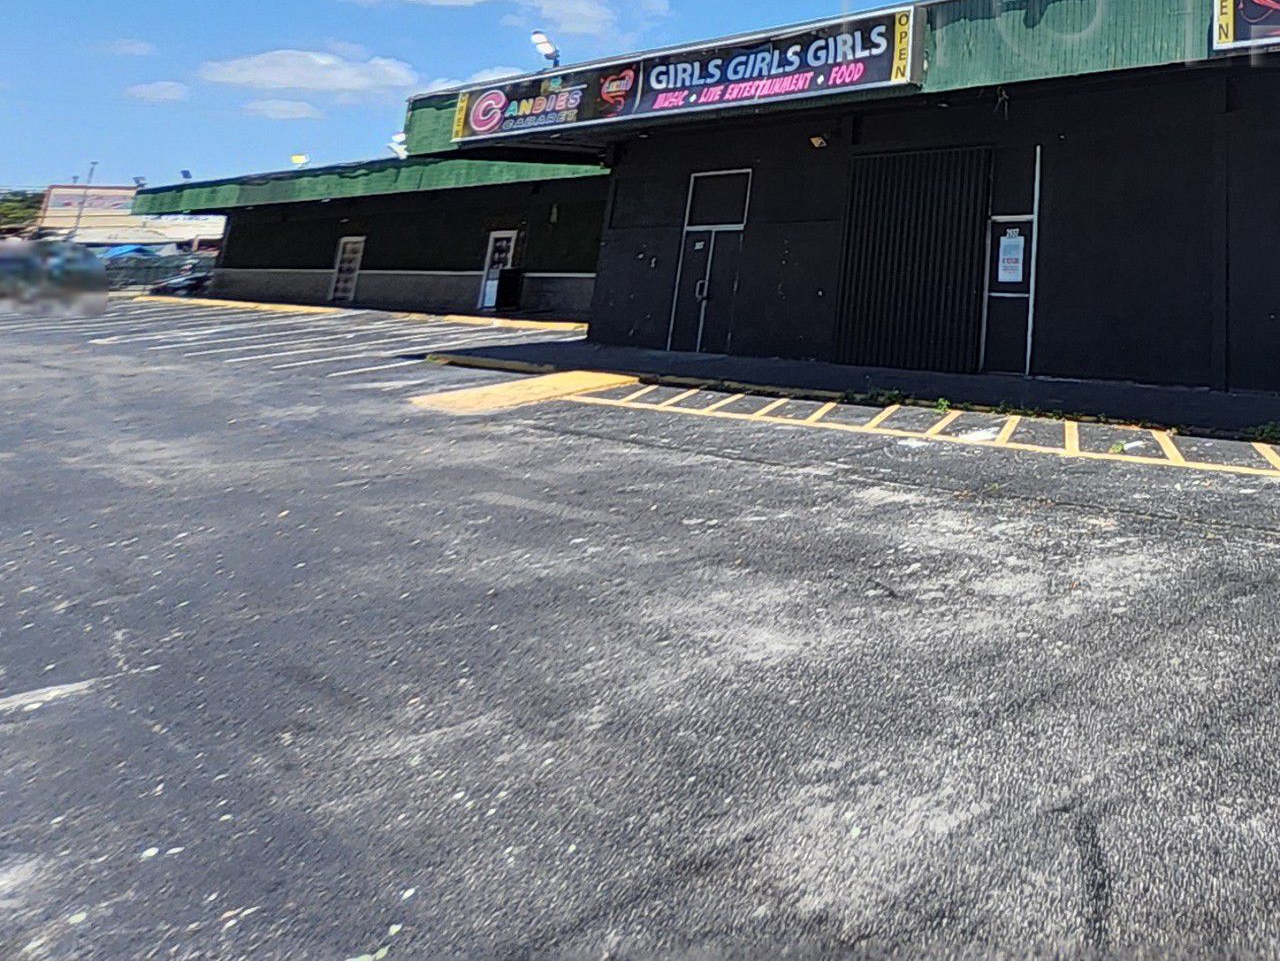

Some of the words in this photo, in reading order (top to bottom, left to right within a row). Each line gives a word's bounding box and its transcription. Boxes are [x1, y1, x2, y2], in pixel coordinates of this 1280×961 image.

[650, 59, 721, 89] GIRLS
[727, 45, 800, 80] GIRLS
[807, 26, 888, 66] GIRLS
[895, 13, 909, 80] OPEN
[470, 89, 583, 135] CANDIES
[653, 89, 688, 110] MUSIC
[698, 87, 723, 104] LIVE
[724, 71, 814, 101] ENTERTAINMENT
[828, 62, 866, 85] FOOD
